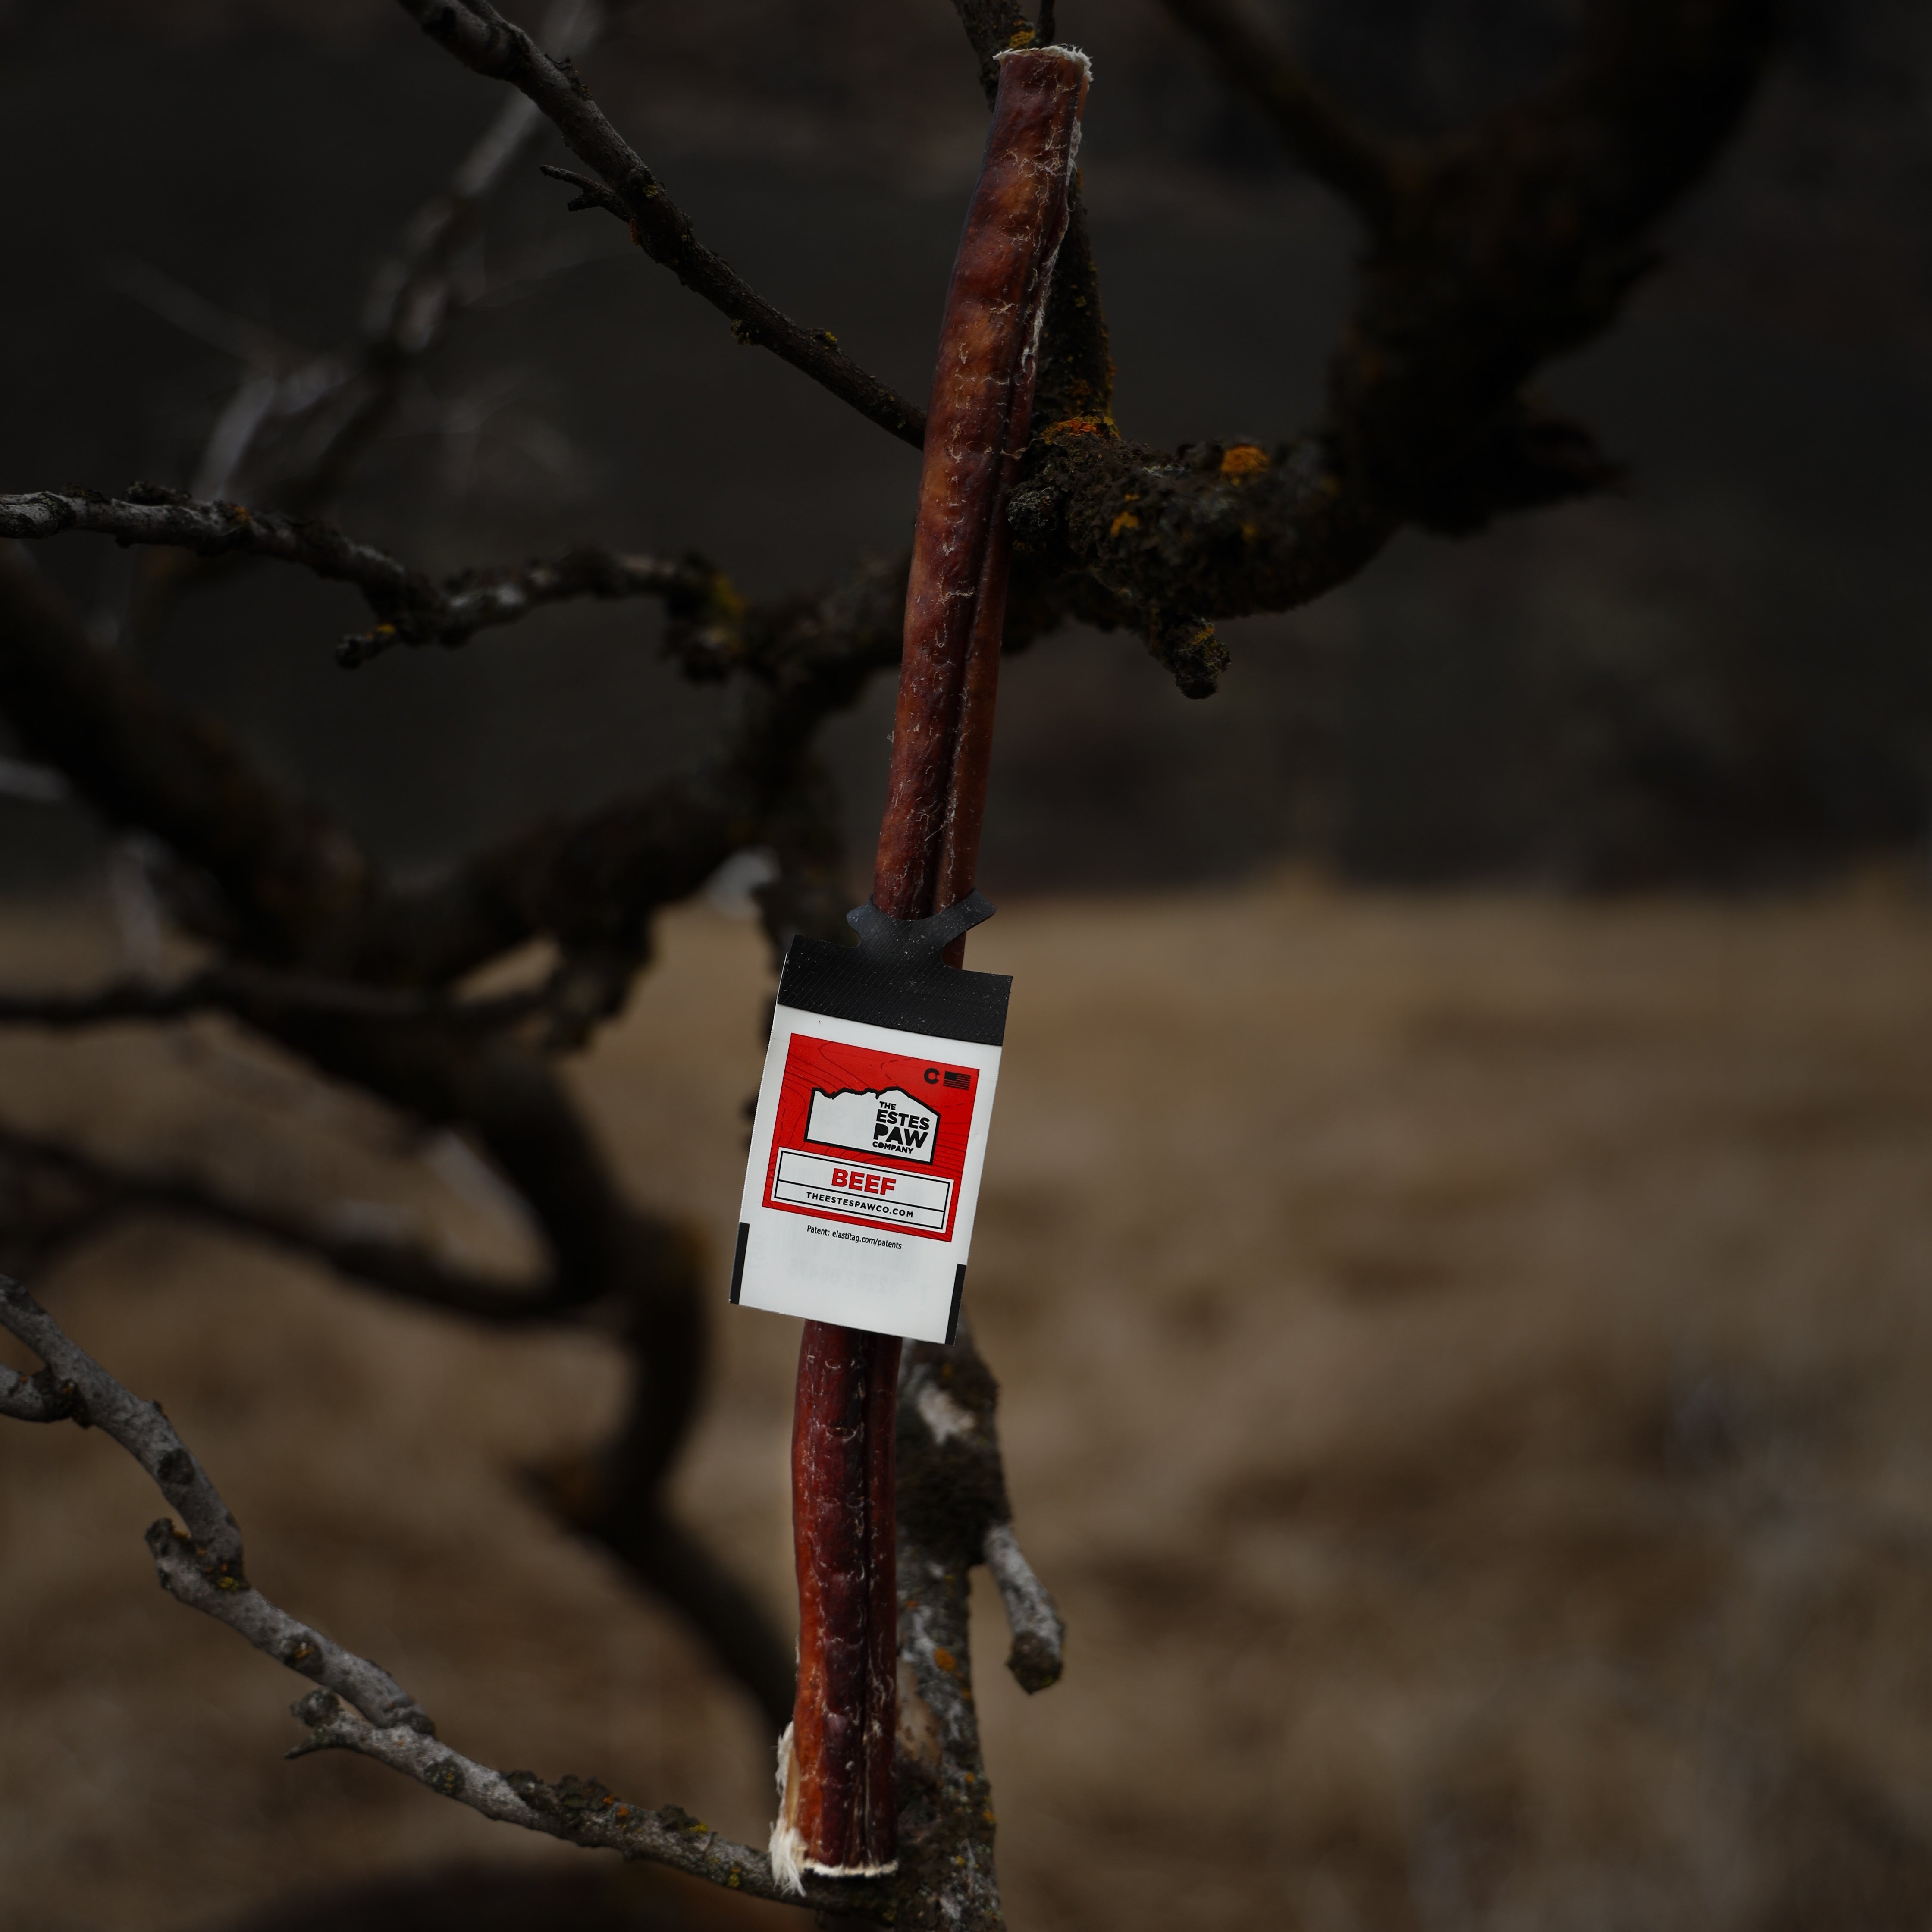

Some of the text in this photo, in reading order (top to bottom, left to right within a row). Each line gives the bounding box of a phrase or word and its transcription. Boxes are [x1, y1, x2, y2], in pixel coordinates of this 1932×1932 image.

[879, 1101, 896, 1110] THE
[876, 1109, 930, 1130] ESTES
[872, 1141, 914, 1154] COMPANY
[873, 1123, 928, 1148] PAW
[831, 1168, 896, 1195] BEEF
[806, 1192, 913, 1217] THEESTESPAWCO.COM
[807, 1225, 902, 1249] Patent: elastitag.com/patents
